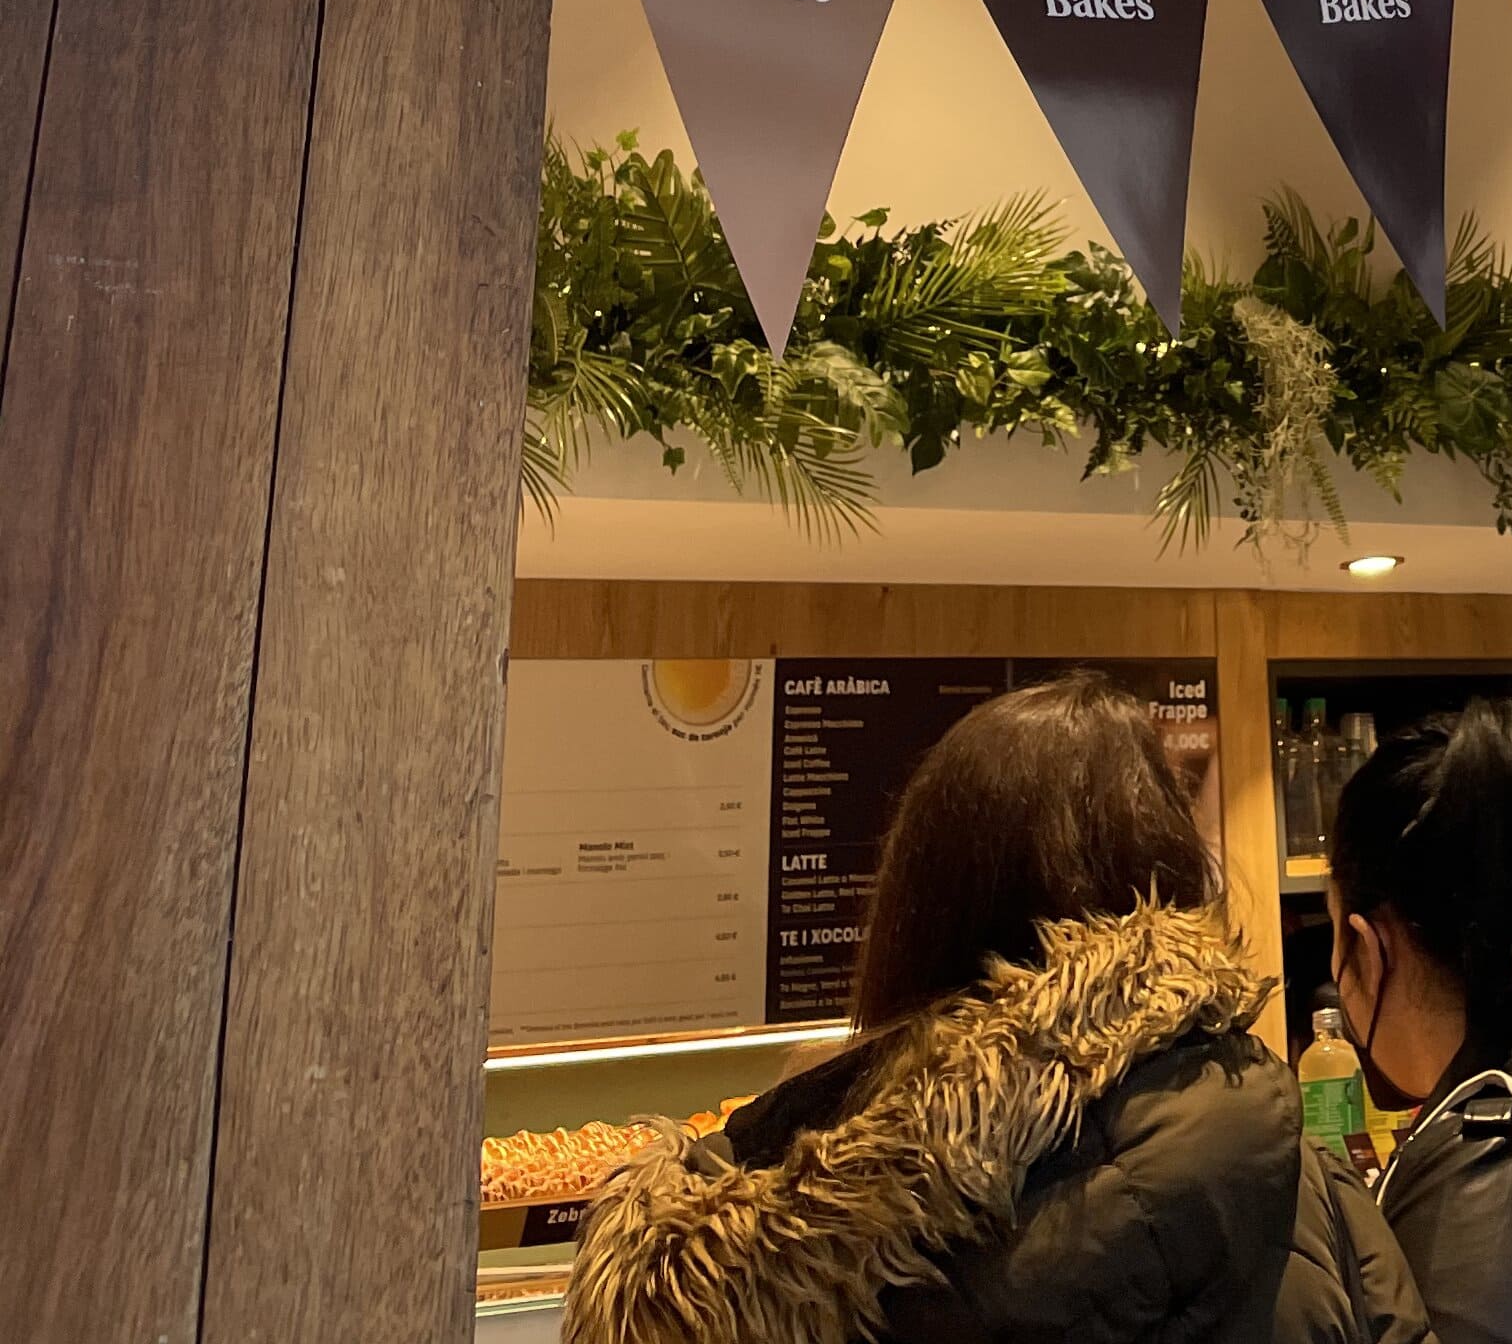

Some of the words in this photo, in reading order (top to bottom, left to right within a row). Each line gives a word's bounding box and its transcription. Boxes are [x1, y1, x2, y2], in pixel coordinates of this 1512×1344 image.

[784, 676, 822, 695] CAFÈ
[826, 676, 890, 695] ARÀBICA
[1169, 679, 1206, 699] Iced
[1148, 701, 1208, 725] Frappe
[781, 854, 828, 872] LATTE
[780, 930, 799, 947] TE
[802, 930, 807, 946] I
